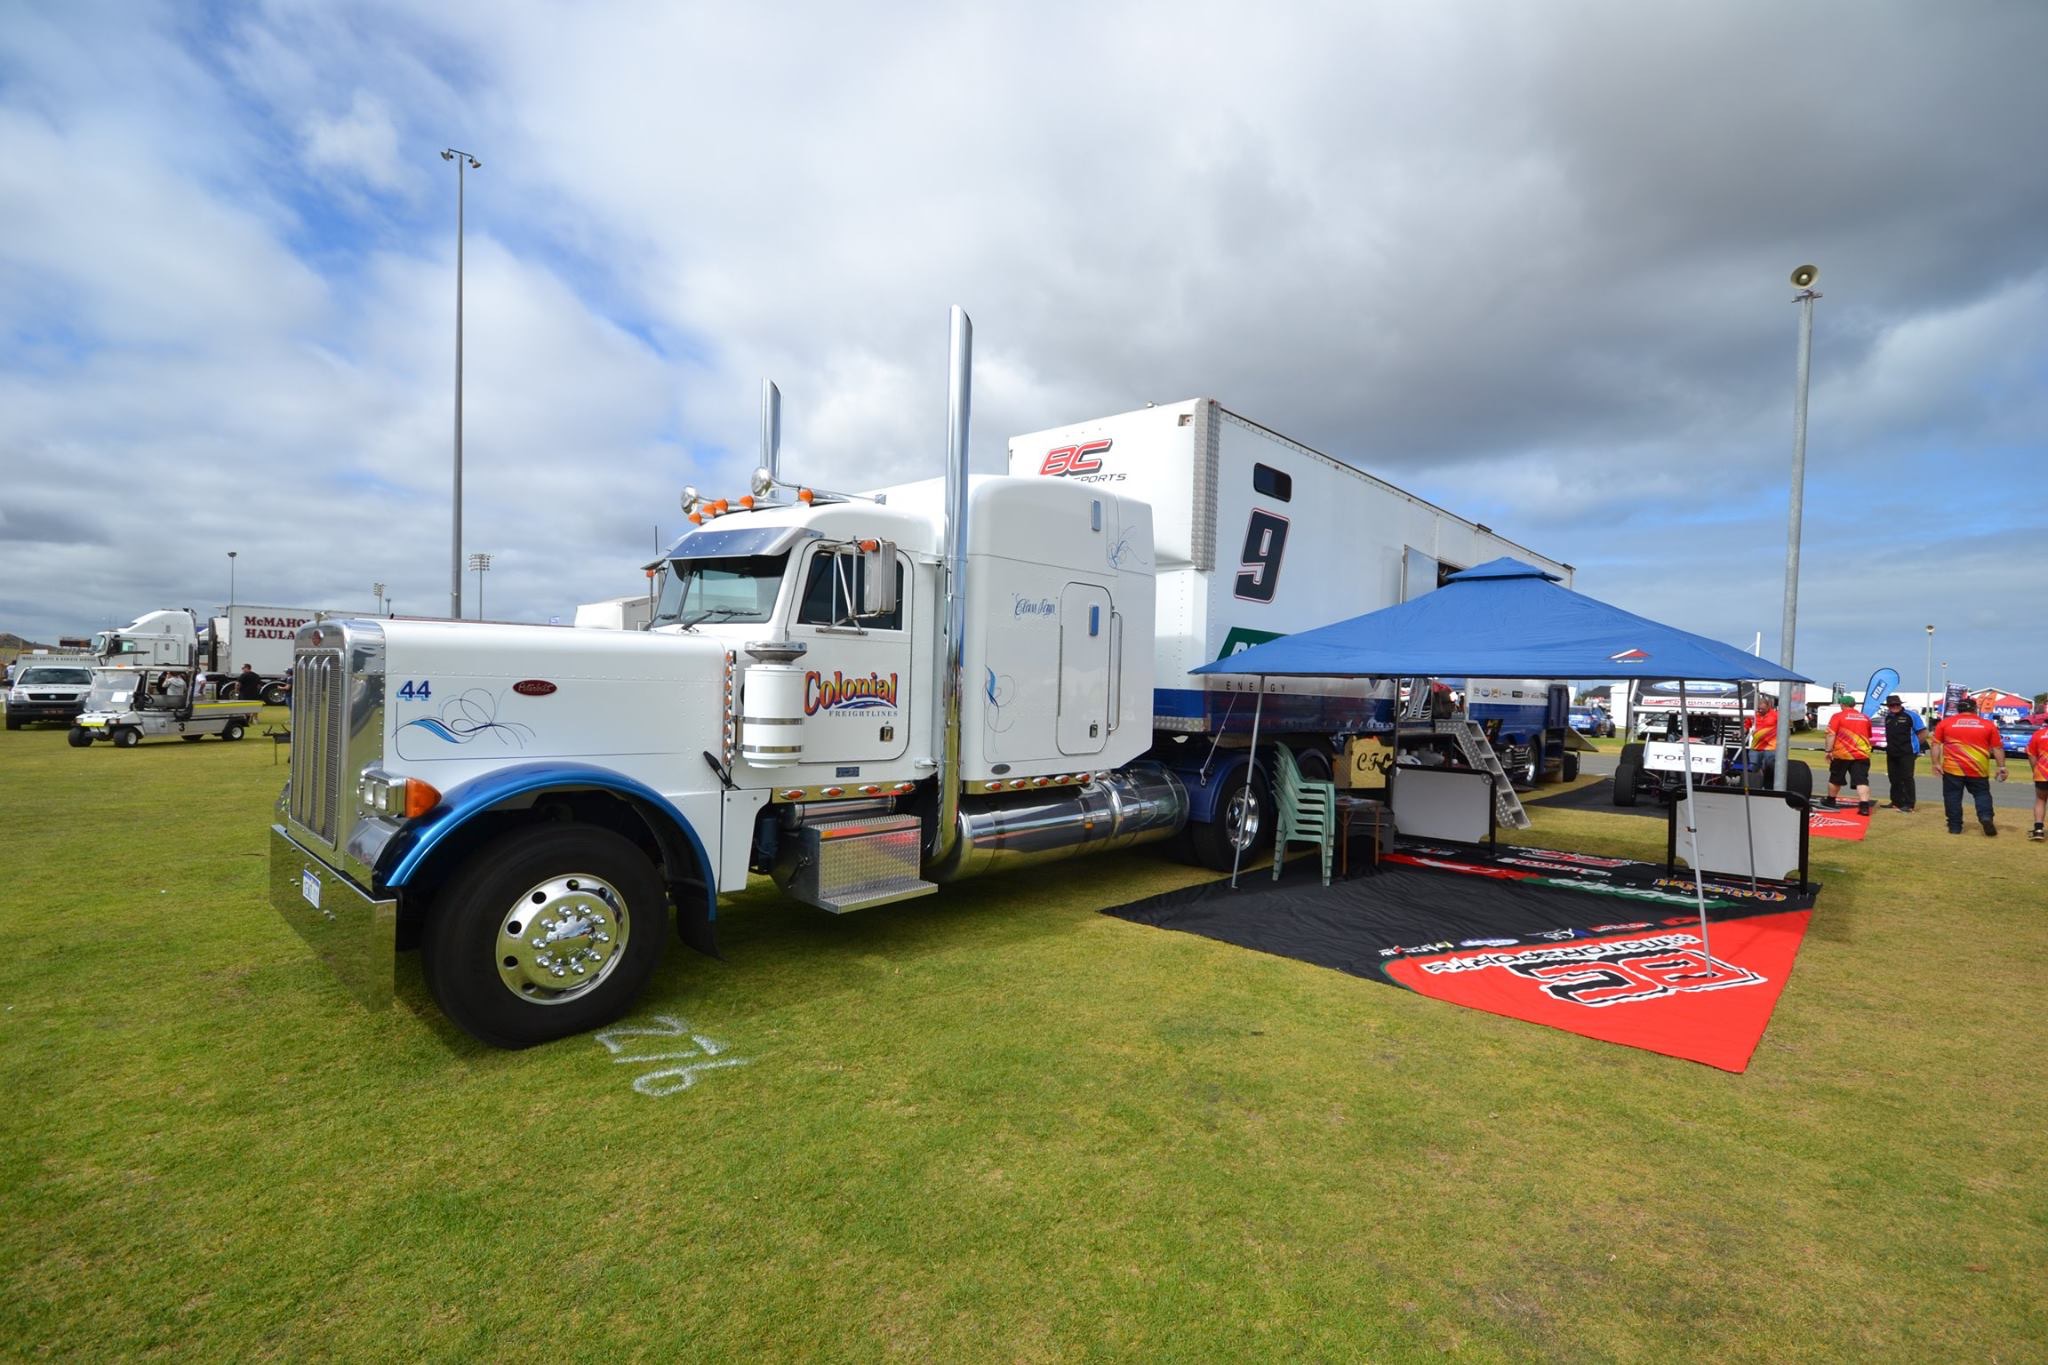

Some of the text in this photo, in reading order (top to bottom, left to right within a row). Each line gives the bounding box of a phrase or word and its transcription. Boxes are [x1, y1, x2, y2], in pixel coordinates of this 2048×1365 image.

[1039, 439, 1113, 477] BC
[1074, 473, 1127, 483] PORTS
[1234, 508, 1290, 604] 9
[244, 616, 310, 628] McMAHO
[397, 680, 432, 701] 44
[804, 671, 898, 716] Colonial
[1226, 681, 1286, 692] ENEGY
[178, 722, 186, 732] 3
